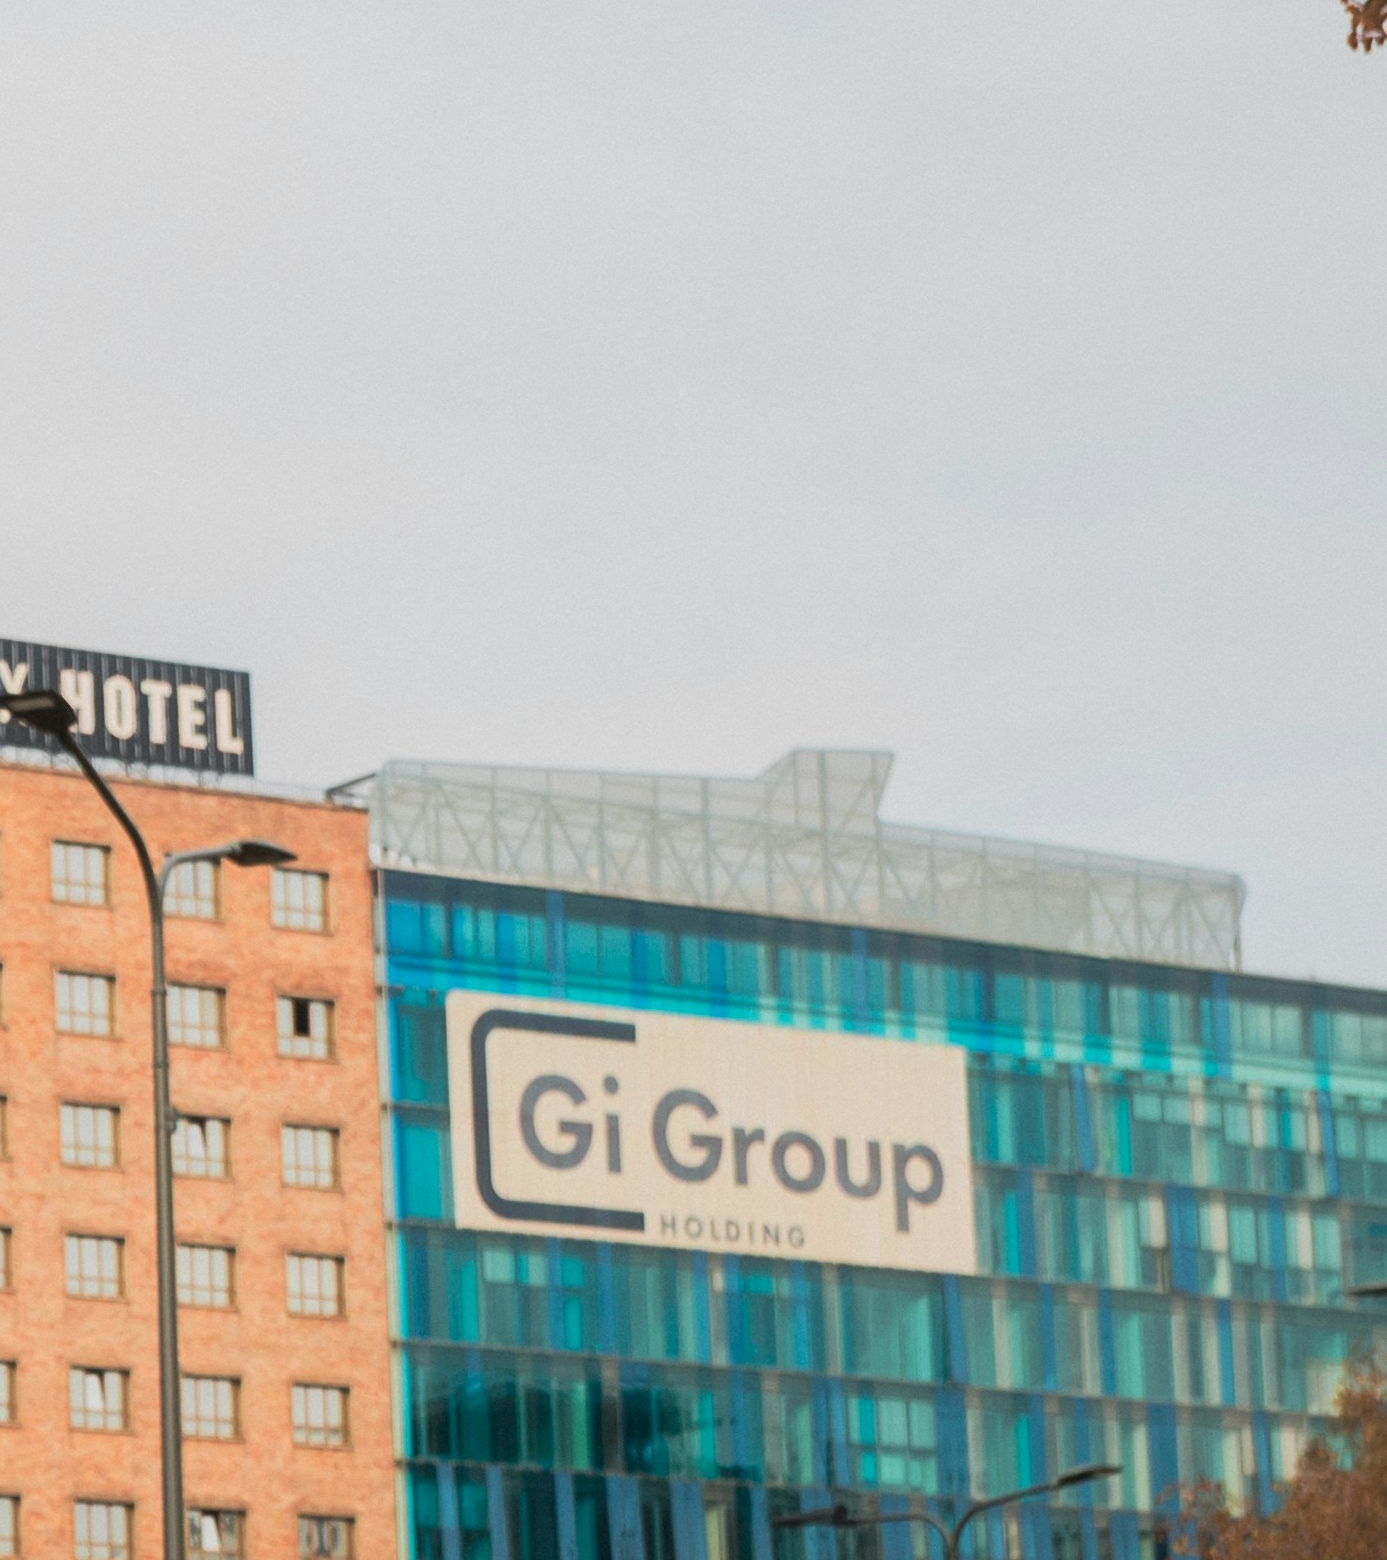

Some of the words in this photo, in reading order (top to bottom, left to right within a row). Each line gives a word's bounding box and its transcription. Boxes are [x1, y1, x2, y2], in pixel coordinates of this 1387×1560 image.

[60, 669, 244, 755] HOTEL
[519, 1074, 622, 1173] Gi
[651, 1088, 945, 1234] Group
[660, 1213, 807, 1249] HOLDING
